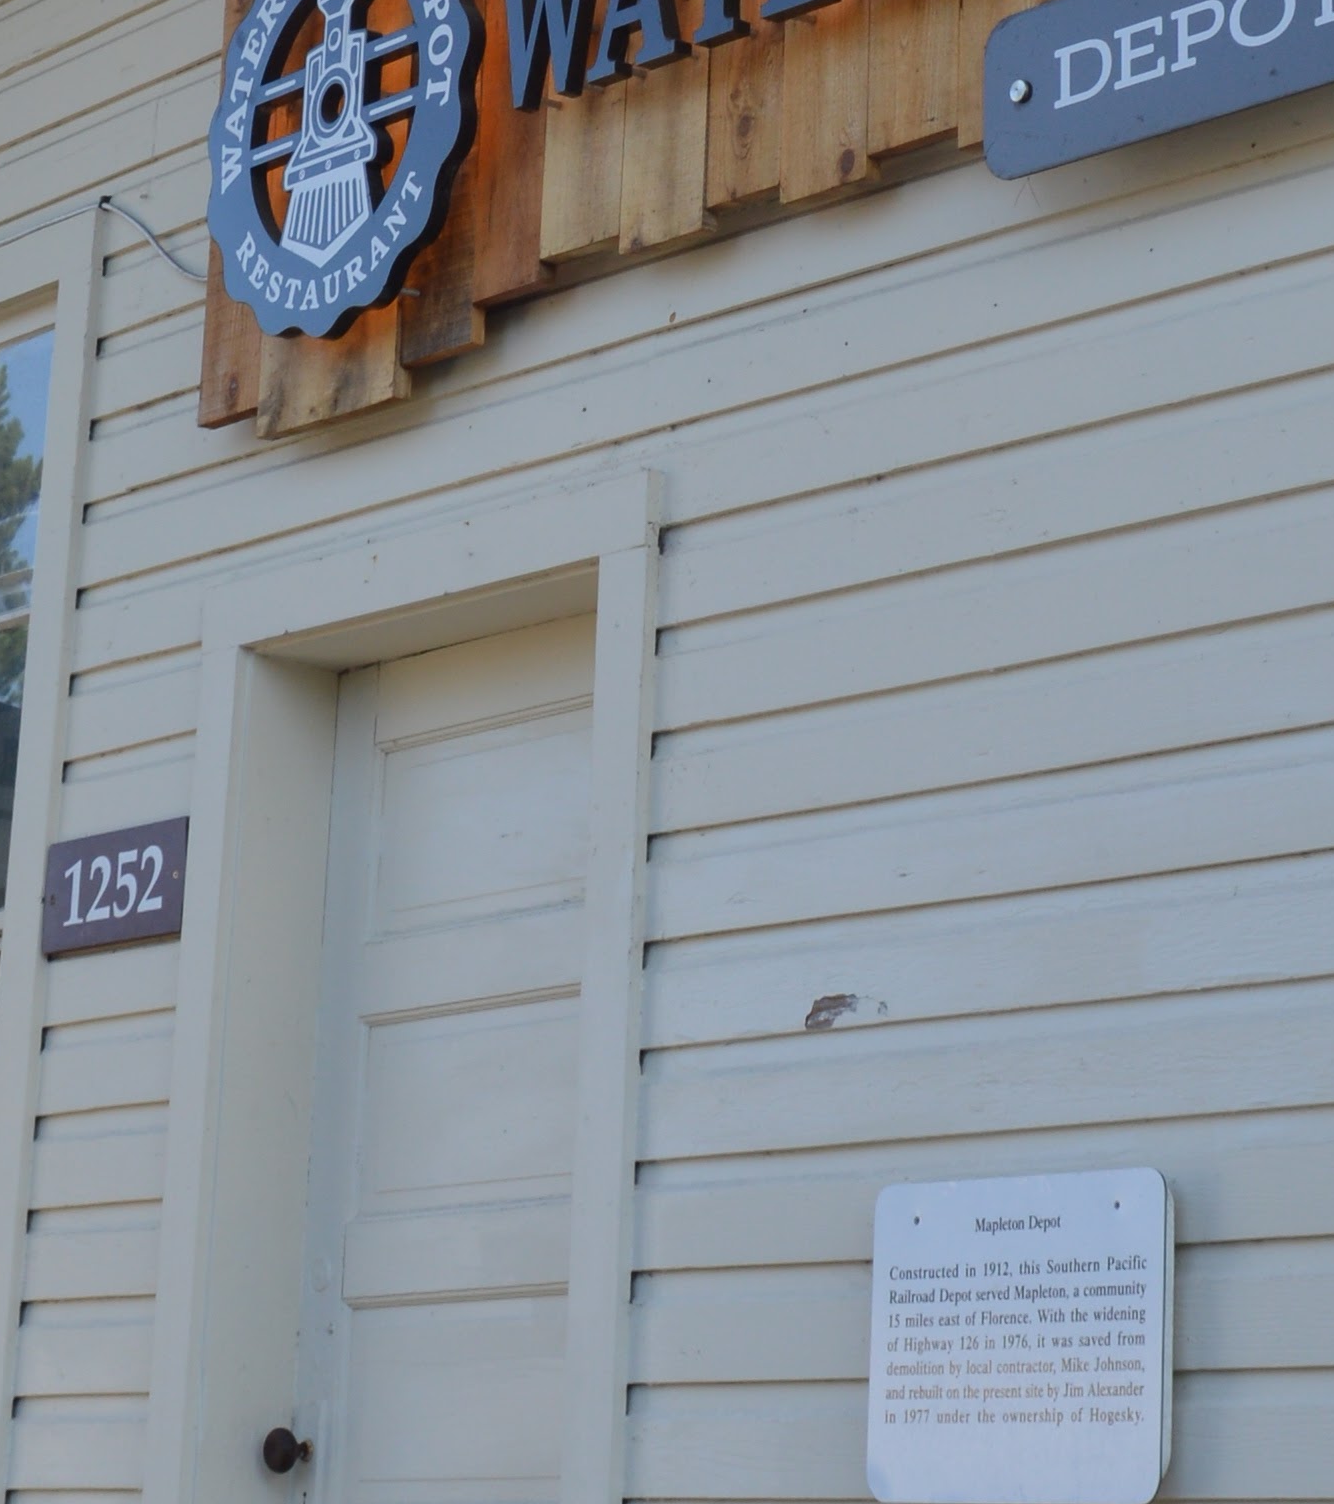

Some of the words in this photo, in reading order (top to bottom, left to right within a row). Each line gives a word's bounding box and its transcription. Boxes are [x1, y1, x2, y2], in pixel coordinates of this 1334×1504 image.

[236, 170, 423, 311] RESTAURANT
[63, 845, 164, 927] 1252
[974, 1217, 1025, 1236] Mapleton
[1028, 1215, 1061, 1233] Depot
[889, 1263, 959, 1281] Constructed
[965, 1262, 977, 1278] in
[983, 1261, 1013, 1278] 1912,
[1019, 1260, 1041, 1275] this
[1046, 1257, 1100, 1275] Southern
[1107, 1254, 1147, 1272] Pacific
[889, 1288, 936, 1305] Railroad
[939, 1287, 972, 1307] Depot
[975, 1285, 1010, 1302] served
[1014, 1283, 1069, 1304] Mapleton,
[1073, 1286, 1080, 1298] a
[1083, 1280, 1147, 1299] community
[889, 1313, 901, 1329] 15
[905, 1312, 934, 1328] miles
[938, 1312, 960, 1328] east
[965, 1311, 976, 1327] of
[981, 1309, 1032, 1326] Florence.
[1037, 1308, 1065, 1324] With
[1070, 1307, 1089, 1323] the
[1093, 1305, 1146, 1325] widening
[887, 1337, 899, 1353] of
[903, 1336, 954, 1356] Highway
[960, 1335, 979, 1351] 126
[984, 1335, 996, 1351] in
[1002, 1333, 1032, 1351] 1976,
[1037, 1333, 1045, 1349] it
[1051, 1335, 1073, 1348] was
[1078, 1331, 1111, 1347] saved
[1117, 1330, 1146, 1346] from
[886, 1360, 945, 1377] demolition
[948, 1359, 962, 1379] by
[966, 1359, 992, 1375] local
[996, 1358, 1056, 1375] contractor,
[1061, 1357, 1089, 1373] Mike
[1093, 1355, 1146, 1373] Johnson,
[885, 1385, 905, 1401] and
[908, 1384, 943, 1400] rebuilt
[946, 1389, 960, 1400] on
[962, 1384, 980, 1400] the
[983, 1386, 1022, 1404] present
[1025, 1383, 1044, 1399] site
[1046, 1382, 1061, 1403] by
[1063, 1382, 1084, 1398] Jim
[1087, 1381, 1145, 1397] Alexander
[884, 1409, 897, 1425] in
[903, 1408, 930, 1425] 1977
[936, 1408, 970, 1424] under
[977, 1407, 996, 1424] the
[1002, 1406, 1064, 1427] ownership
[1070, 1407, 1083, 1423] of
[1089, 1406, 1145, 1426] Hogesky.
